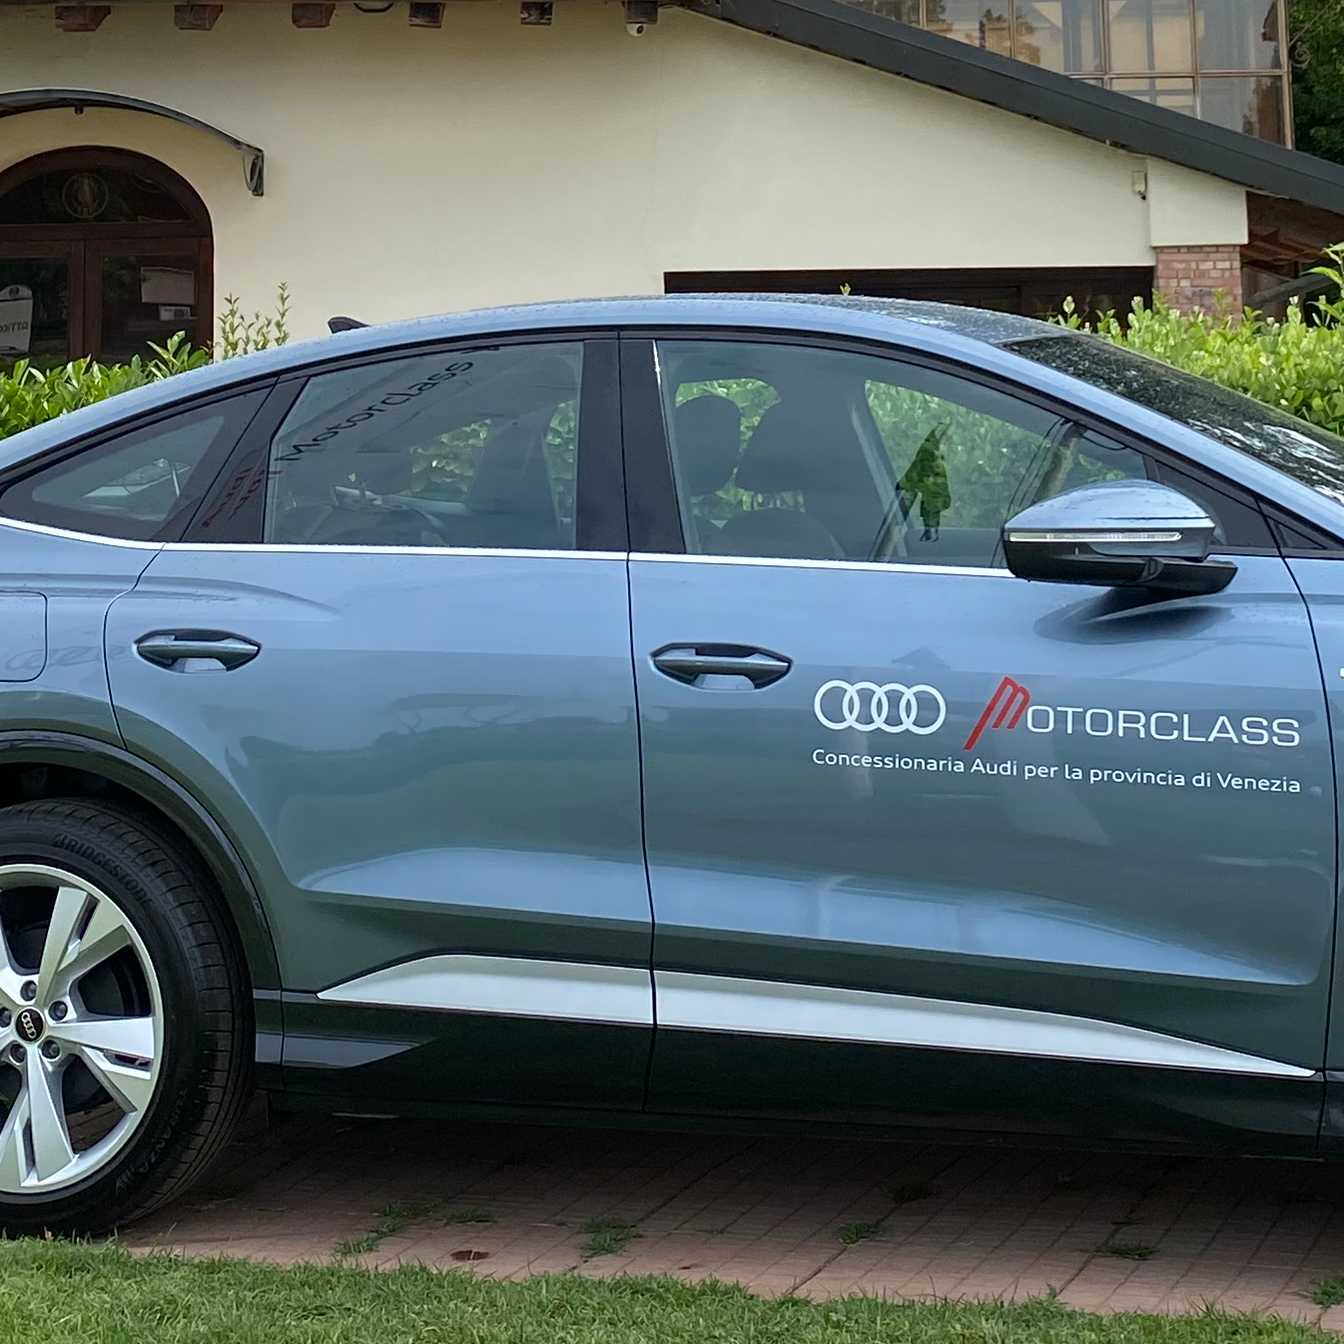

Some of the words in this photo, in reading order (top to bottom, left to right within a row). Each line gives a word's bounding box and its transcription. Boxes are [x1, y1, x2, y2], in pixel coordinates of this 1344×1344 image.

[273, 359, 474, 463] Motorclass
[964, 676, 1300, 751] MOTORCLASS
[812, 749, 965, 773] Concessionaria
[970, 758, 1017, 776] Audi
[1024, 765, 1059, 780] per
[1064, 763, 1083, 780] la
[1090, 767, 1185, 787] provincia
[1192, 772, 1211, 788] di
[1216, 772, 1301, 793] Venezia
